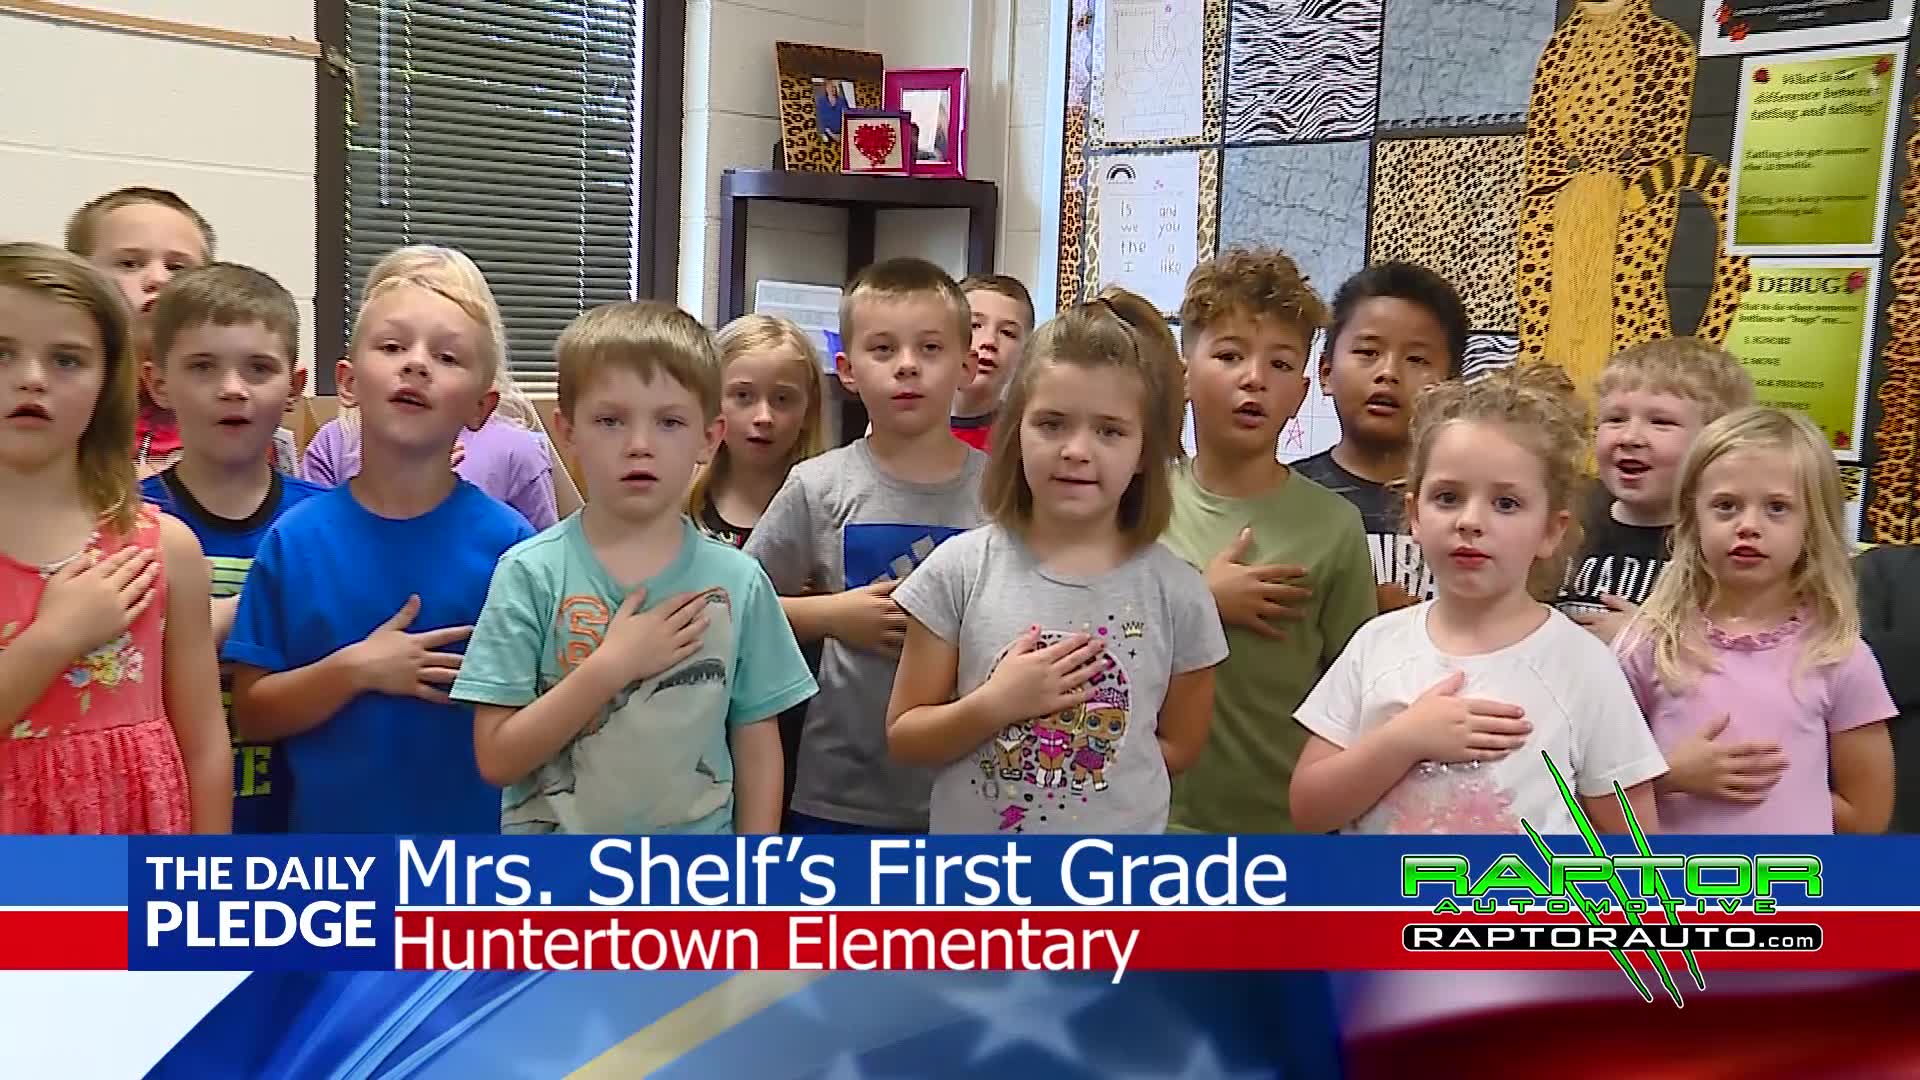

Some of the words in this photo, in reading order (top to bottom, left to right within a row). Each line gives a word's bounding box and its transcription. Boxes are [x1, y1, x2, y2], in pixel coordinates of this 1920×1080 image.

[1820, 72, 1833, 82] is
[1754, 90, 1821, 103] difference
[1751, 107, 1799, 121] tattling
[1800, 105, 1826, 117] and
[1121, 223, 1138, 232] we
[1158, 223, 1180, 240] you
[1121, 241, 1146, 256] the
[1160, 258, 1181, 275] like
[1557, 556, 1664, 602] LOADI
